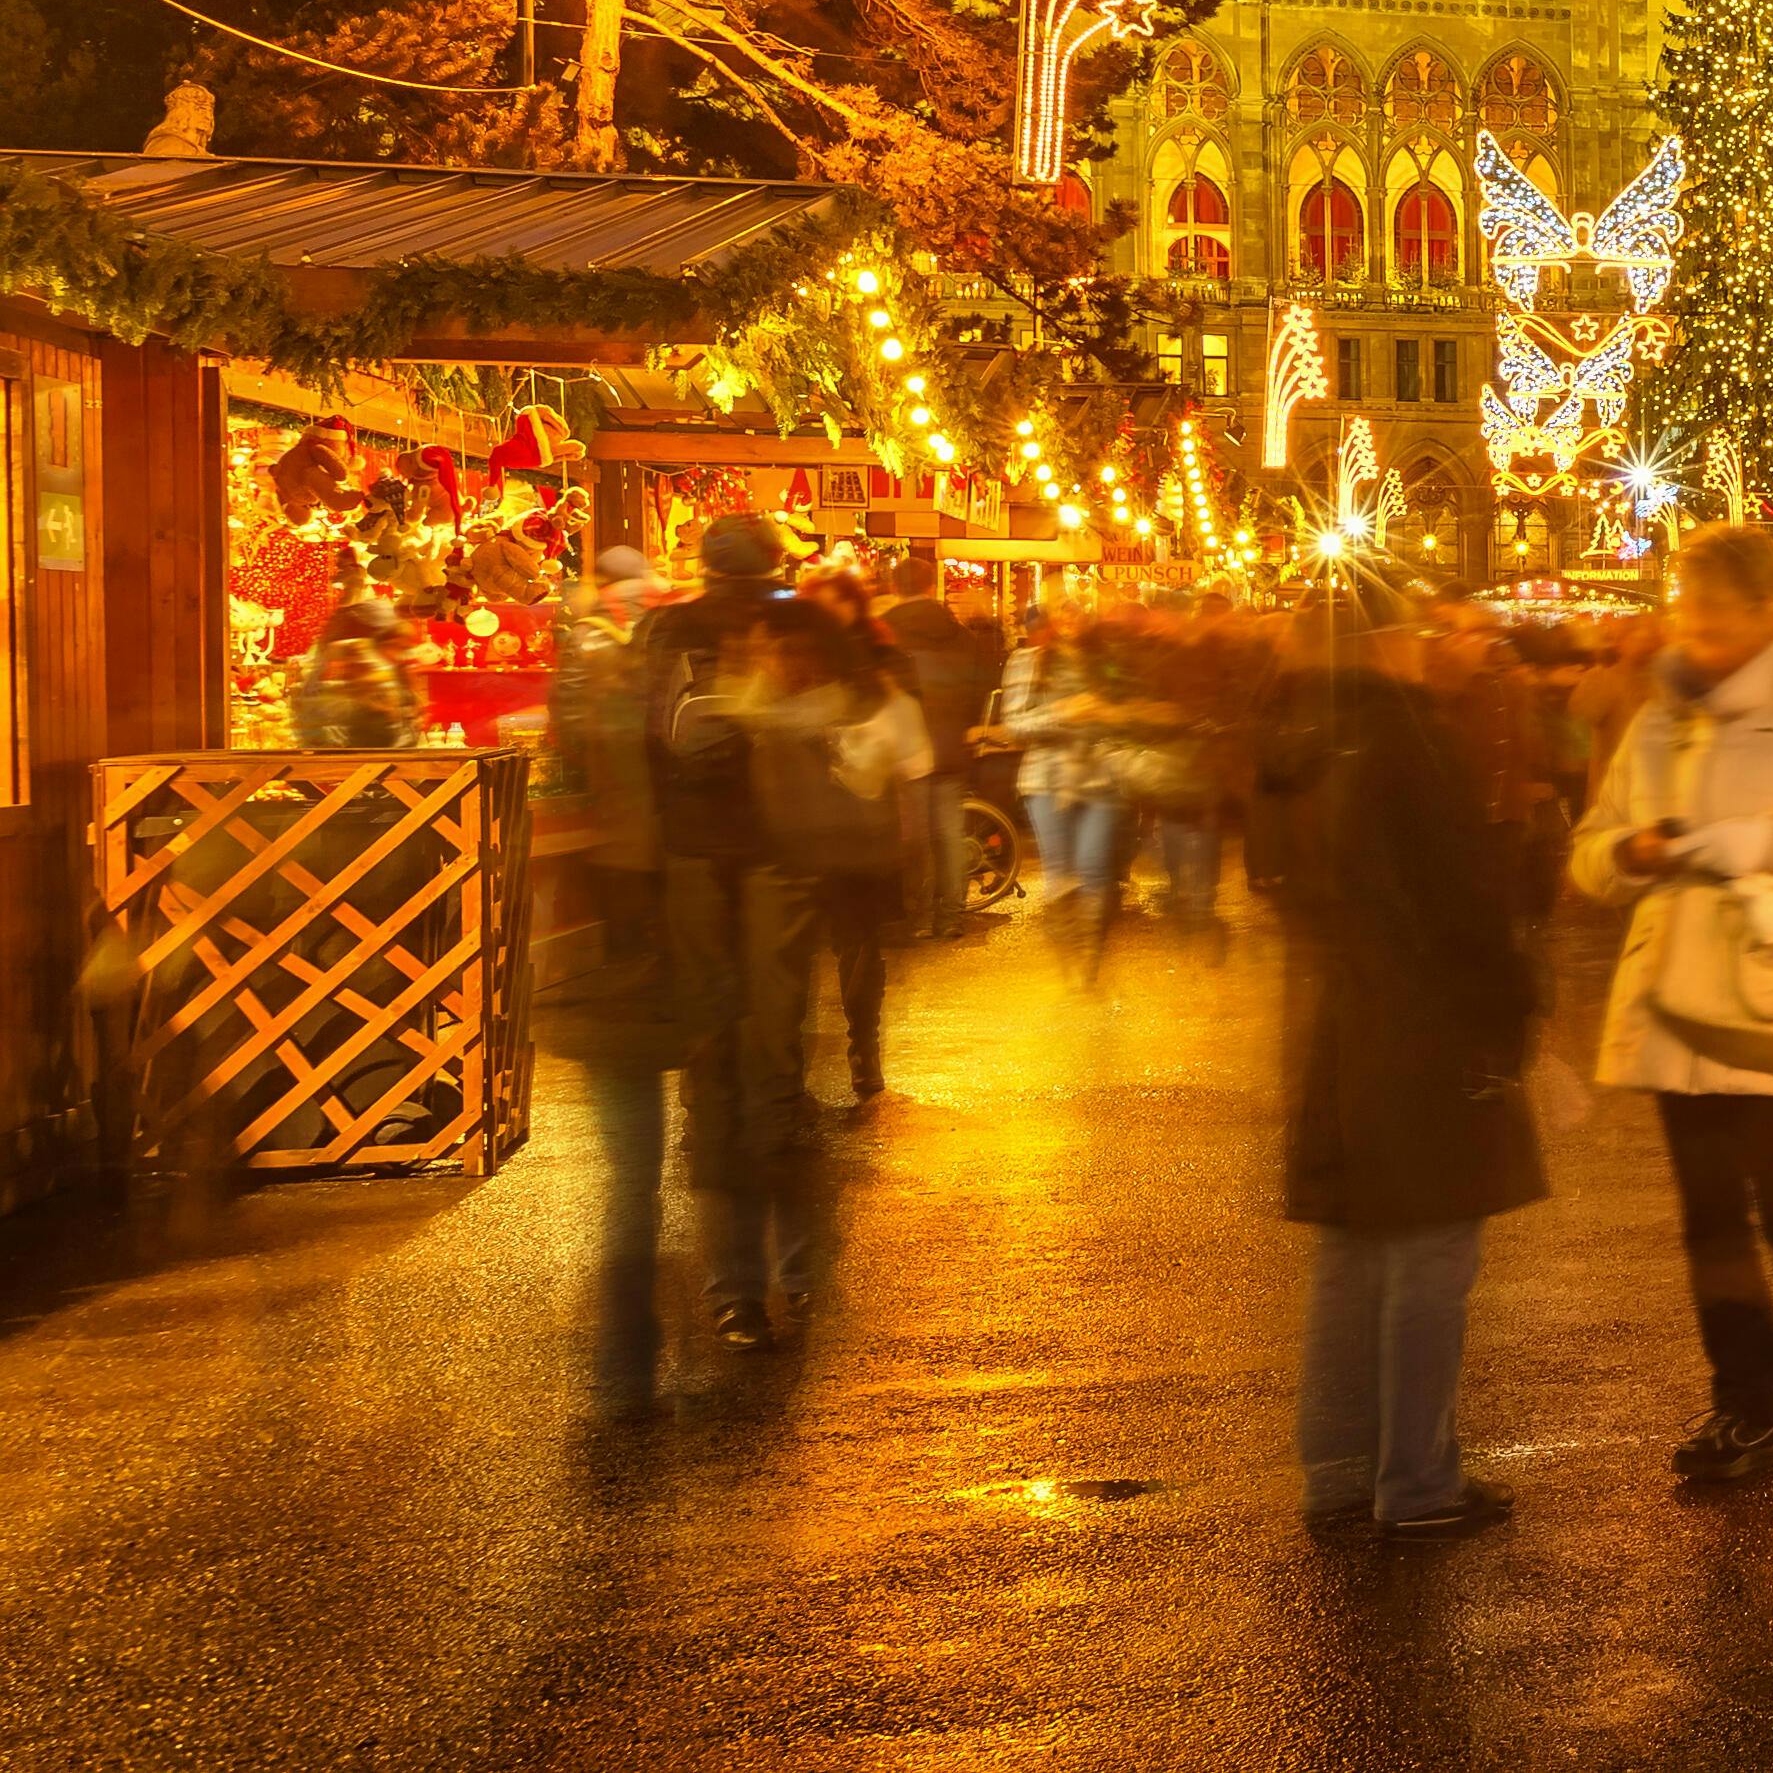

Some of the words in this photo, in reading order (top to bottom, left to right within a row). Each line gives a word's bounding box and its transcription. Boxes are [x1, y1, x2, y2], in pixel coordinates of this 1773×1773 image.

[1101, 546, 1143, 563] WEIN
[1114, 566, 1193, 581] PUNSCH
[1563, 569, 1639, 581] INFORMATION
